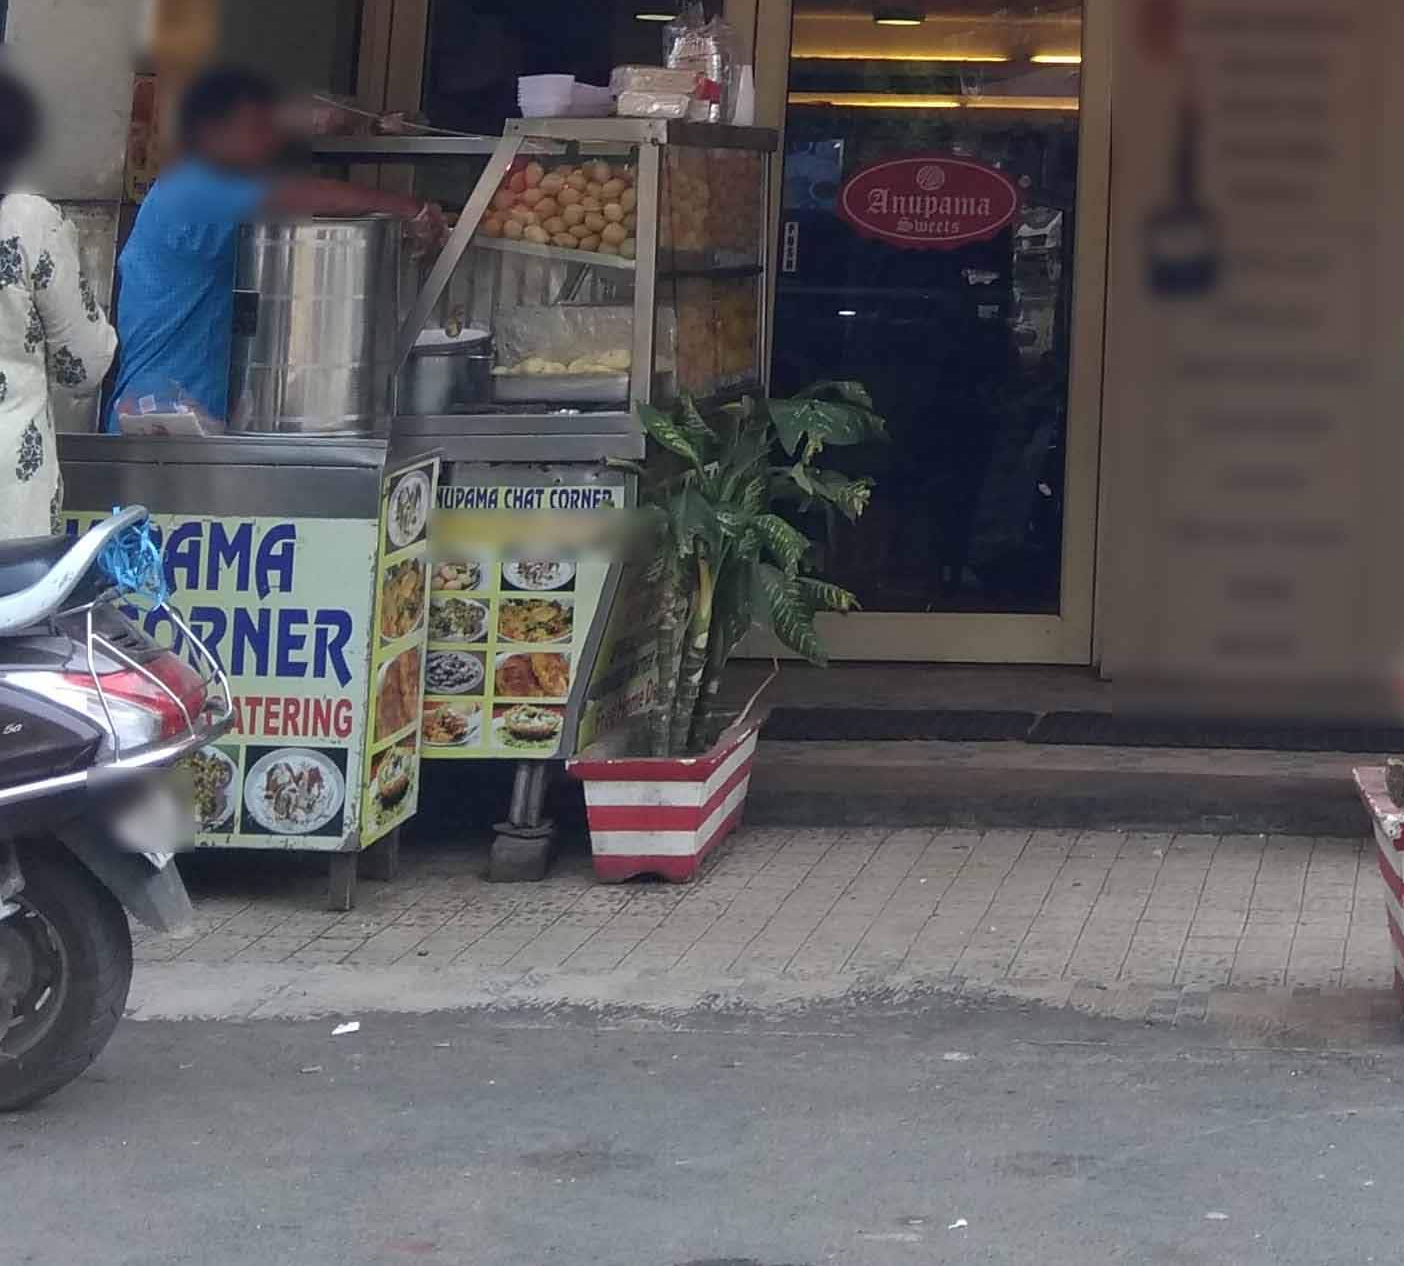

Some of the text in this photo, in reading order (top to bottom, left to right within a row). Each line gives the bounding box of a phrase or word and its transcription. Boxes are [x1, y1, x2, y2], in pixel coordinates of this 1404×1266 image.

[866, 188, 992, 219] Anupama
[896, 216, 961, 234] Sweets
[435, 486, 498, 510] NUPAMA
[504, 487, 545, 510] CHAT
[118, 602, 353, 688] ORNER
